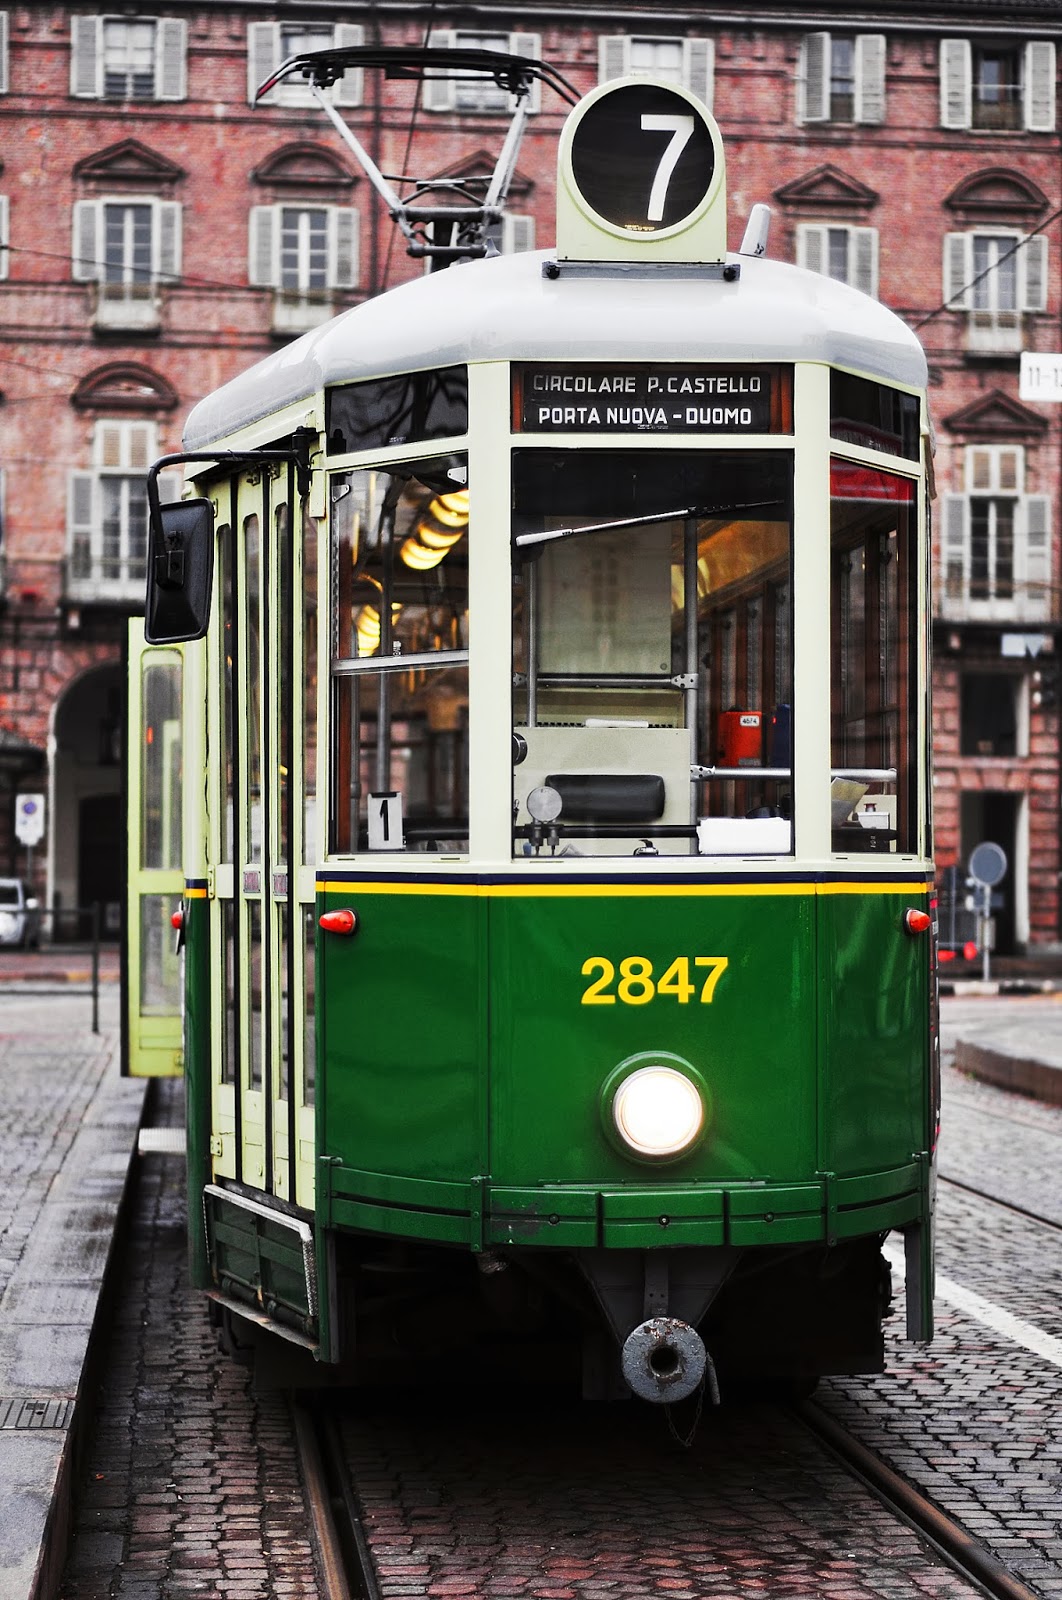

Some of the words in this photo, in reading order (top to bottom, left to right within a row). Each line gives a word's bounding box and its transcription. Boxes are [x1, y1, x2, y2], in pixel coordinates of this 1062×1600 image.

[641, 114, 695, 221] 7
[533, 375, 636, 393] CIRCOLARE
[1029, 366, 1062, 388] 11-1
[538, 407, 601, 424] PORTA
[606, 407, 668, 425] NUOVA
[379, 799, 389, 841] 1
[581, 956, 729, 1004] 2847
